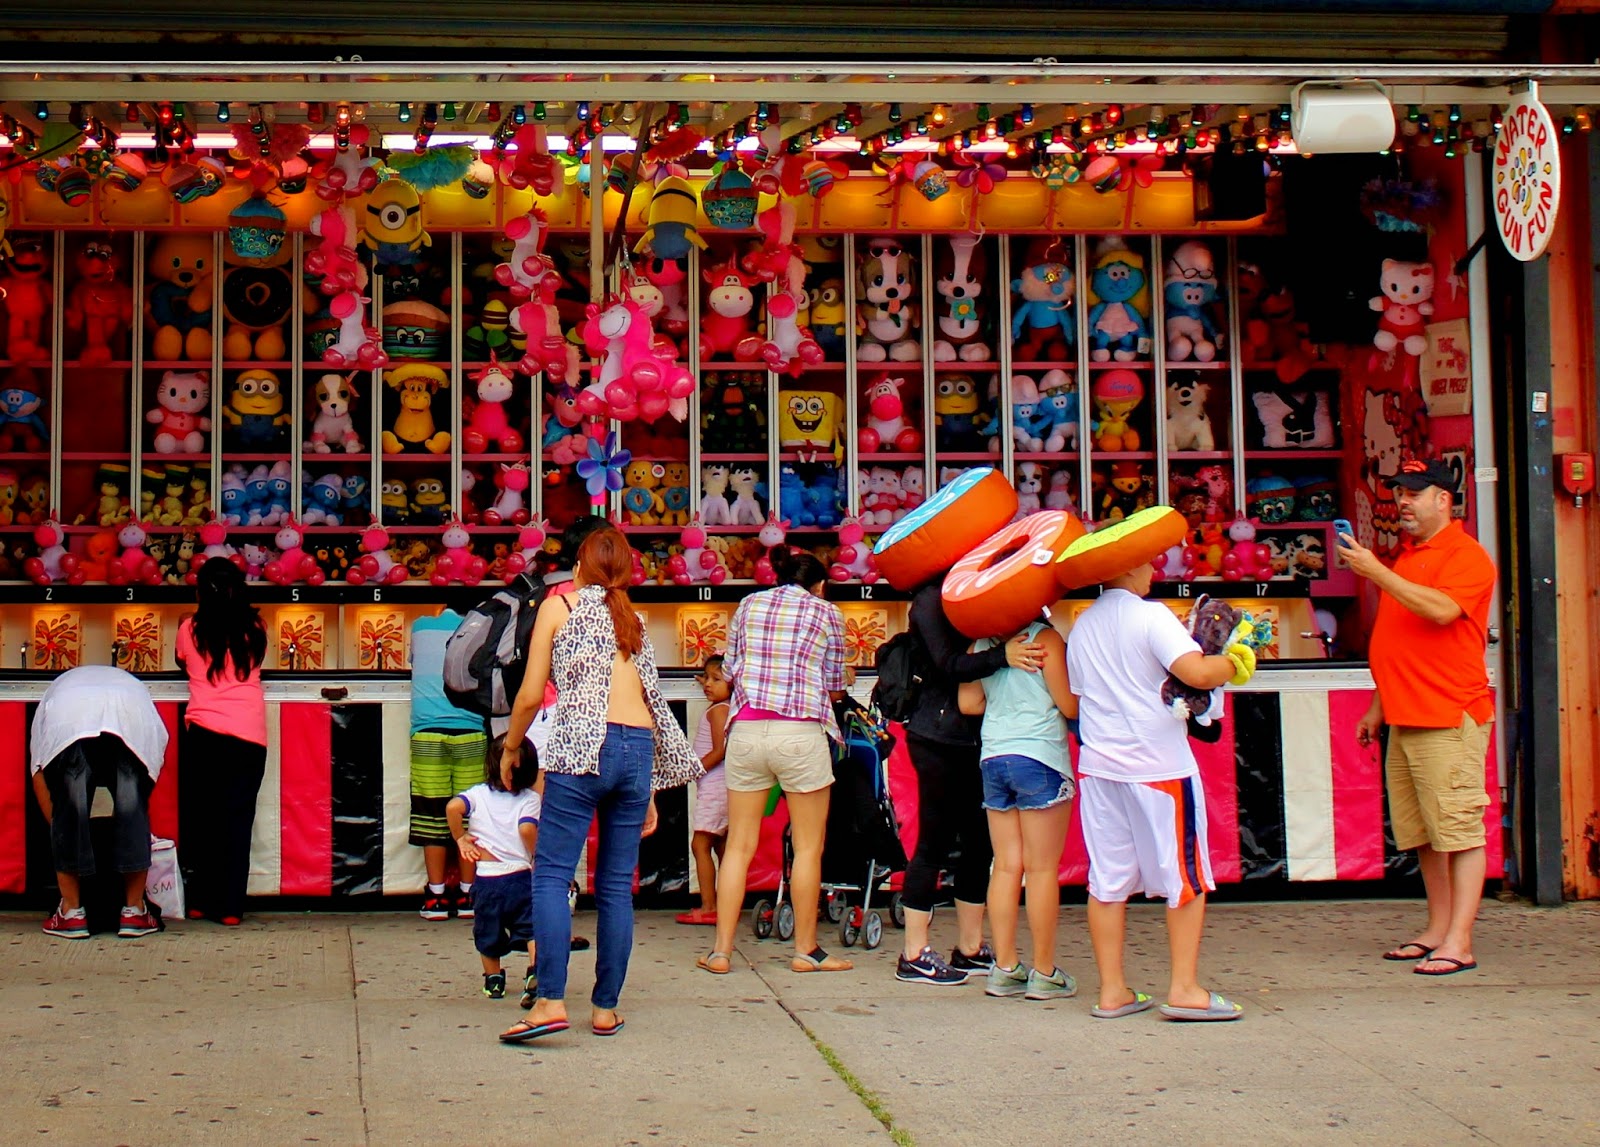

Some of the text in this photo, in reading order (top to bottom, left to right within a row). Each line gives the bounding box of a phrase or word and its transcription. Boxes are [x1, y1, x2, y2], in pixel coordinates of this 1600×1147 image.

[1496, 105, 1547, 166] WATER
[1497, 181, 1552, 253] GUN FUN
[45, 588, 52, 600] 2
[126, 588, 133, 600] 3
[292, 589, 299, 601] 5
[373, 589, 381, 601] 6
[698, 588, 711, 600] 10
[860, 586, 872, 599] 12
[1178, 584, 1190, 597] 16
[1256, 584, 1268, 596] 17
